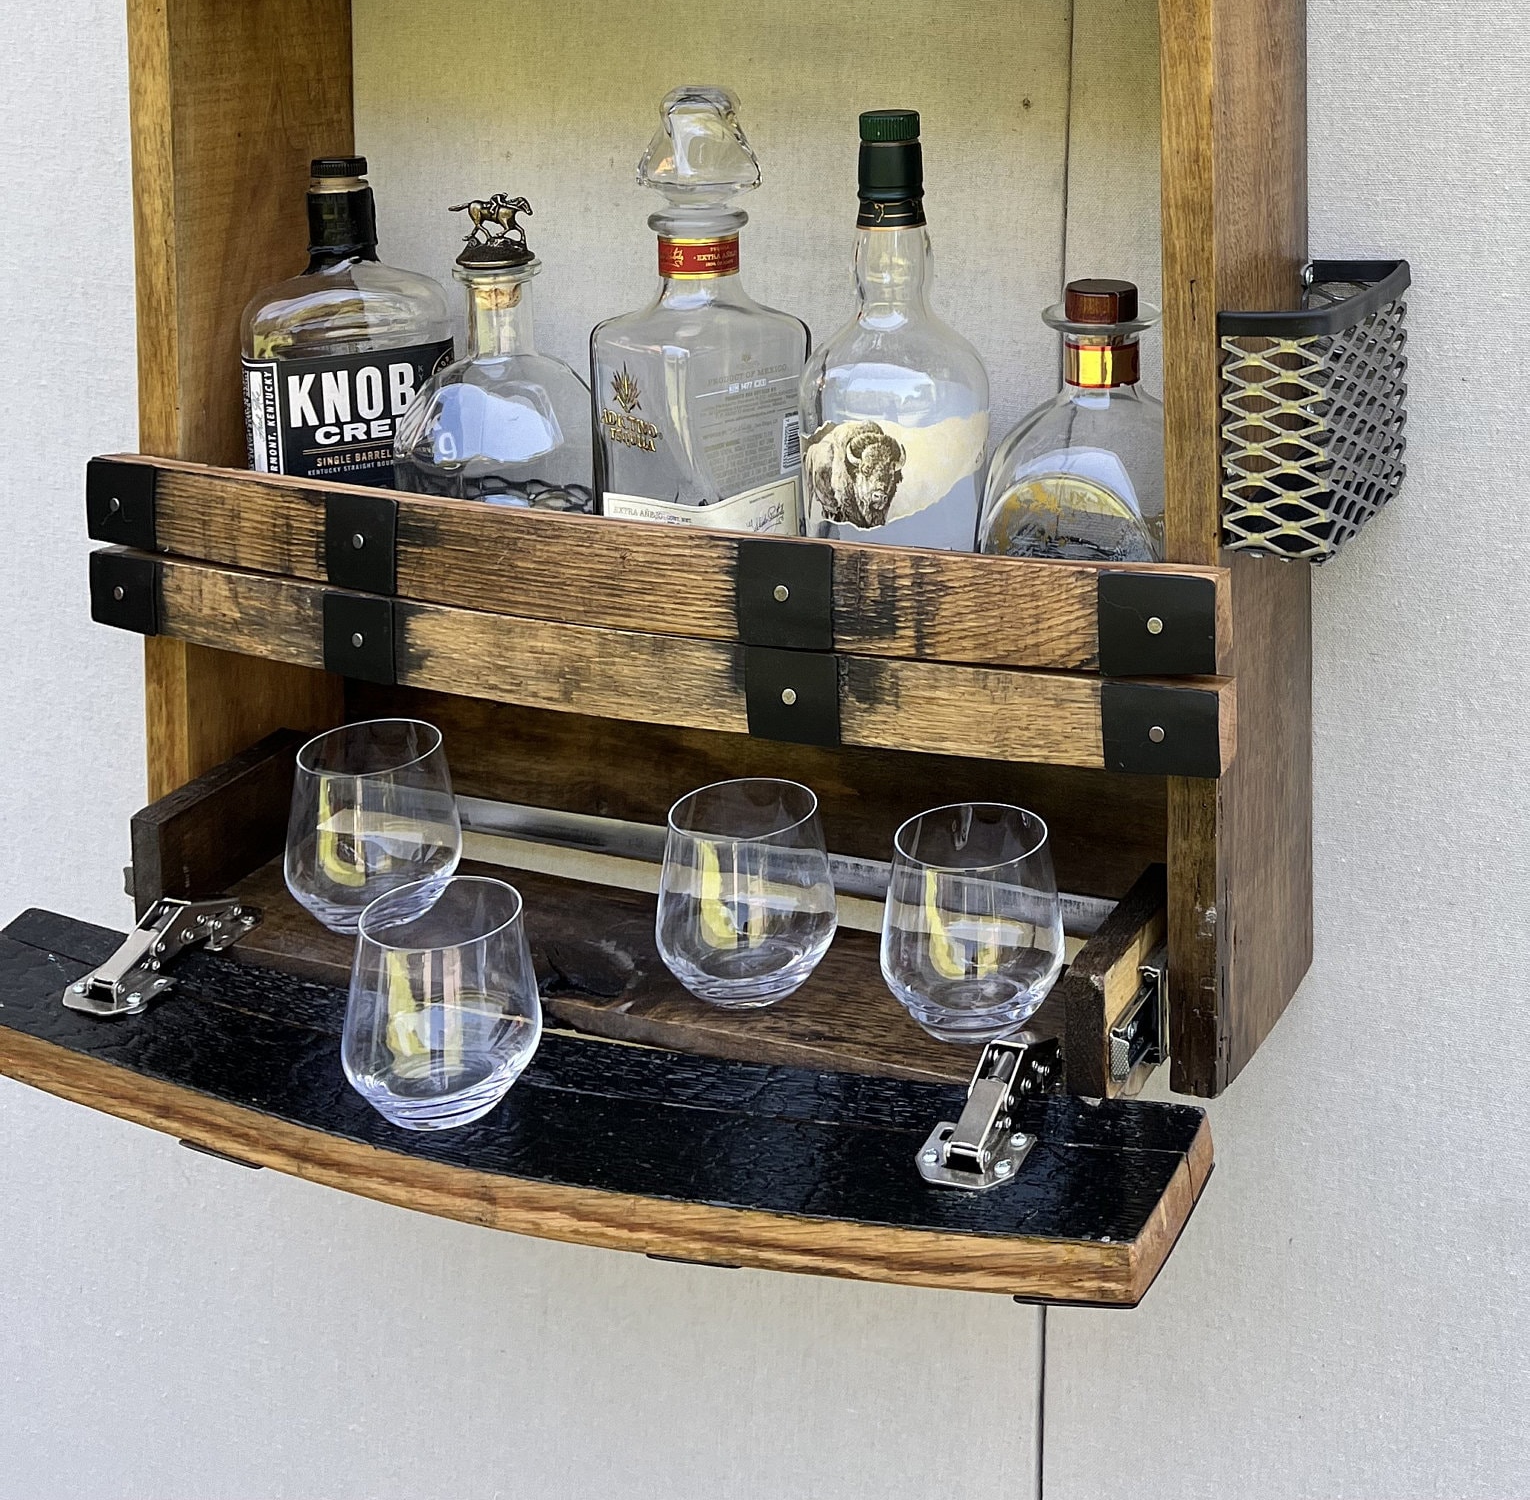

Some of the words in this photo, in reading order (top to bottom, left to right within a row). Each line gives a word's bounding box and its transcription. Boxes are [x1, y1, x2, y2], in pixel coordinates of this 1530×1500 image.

[264, 371, 276, 427] KENTUCKY
[287, 362, 416, 428] KNOB
[317, 455, 351, 468] SINGLE
[355, 449, 392, 463] BARREL
[307, 466, 341, 476] KENTUCKY
[343, 462, 375, 473] STRAIGHT
[613, 506, 638, 517] EXTRA
